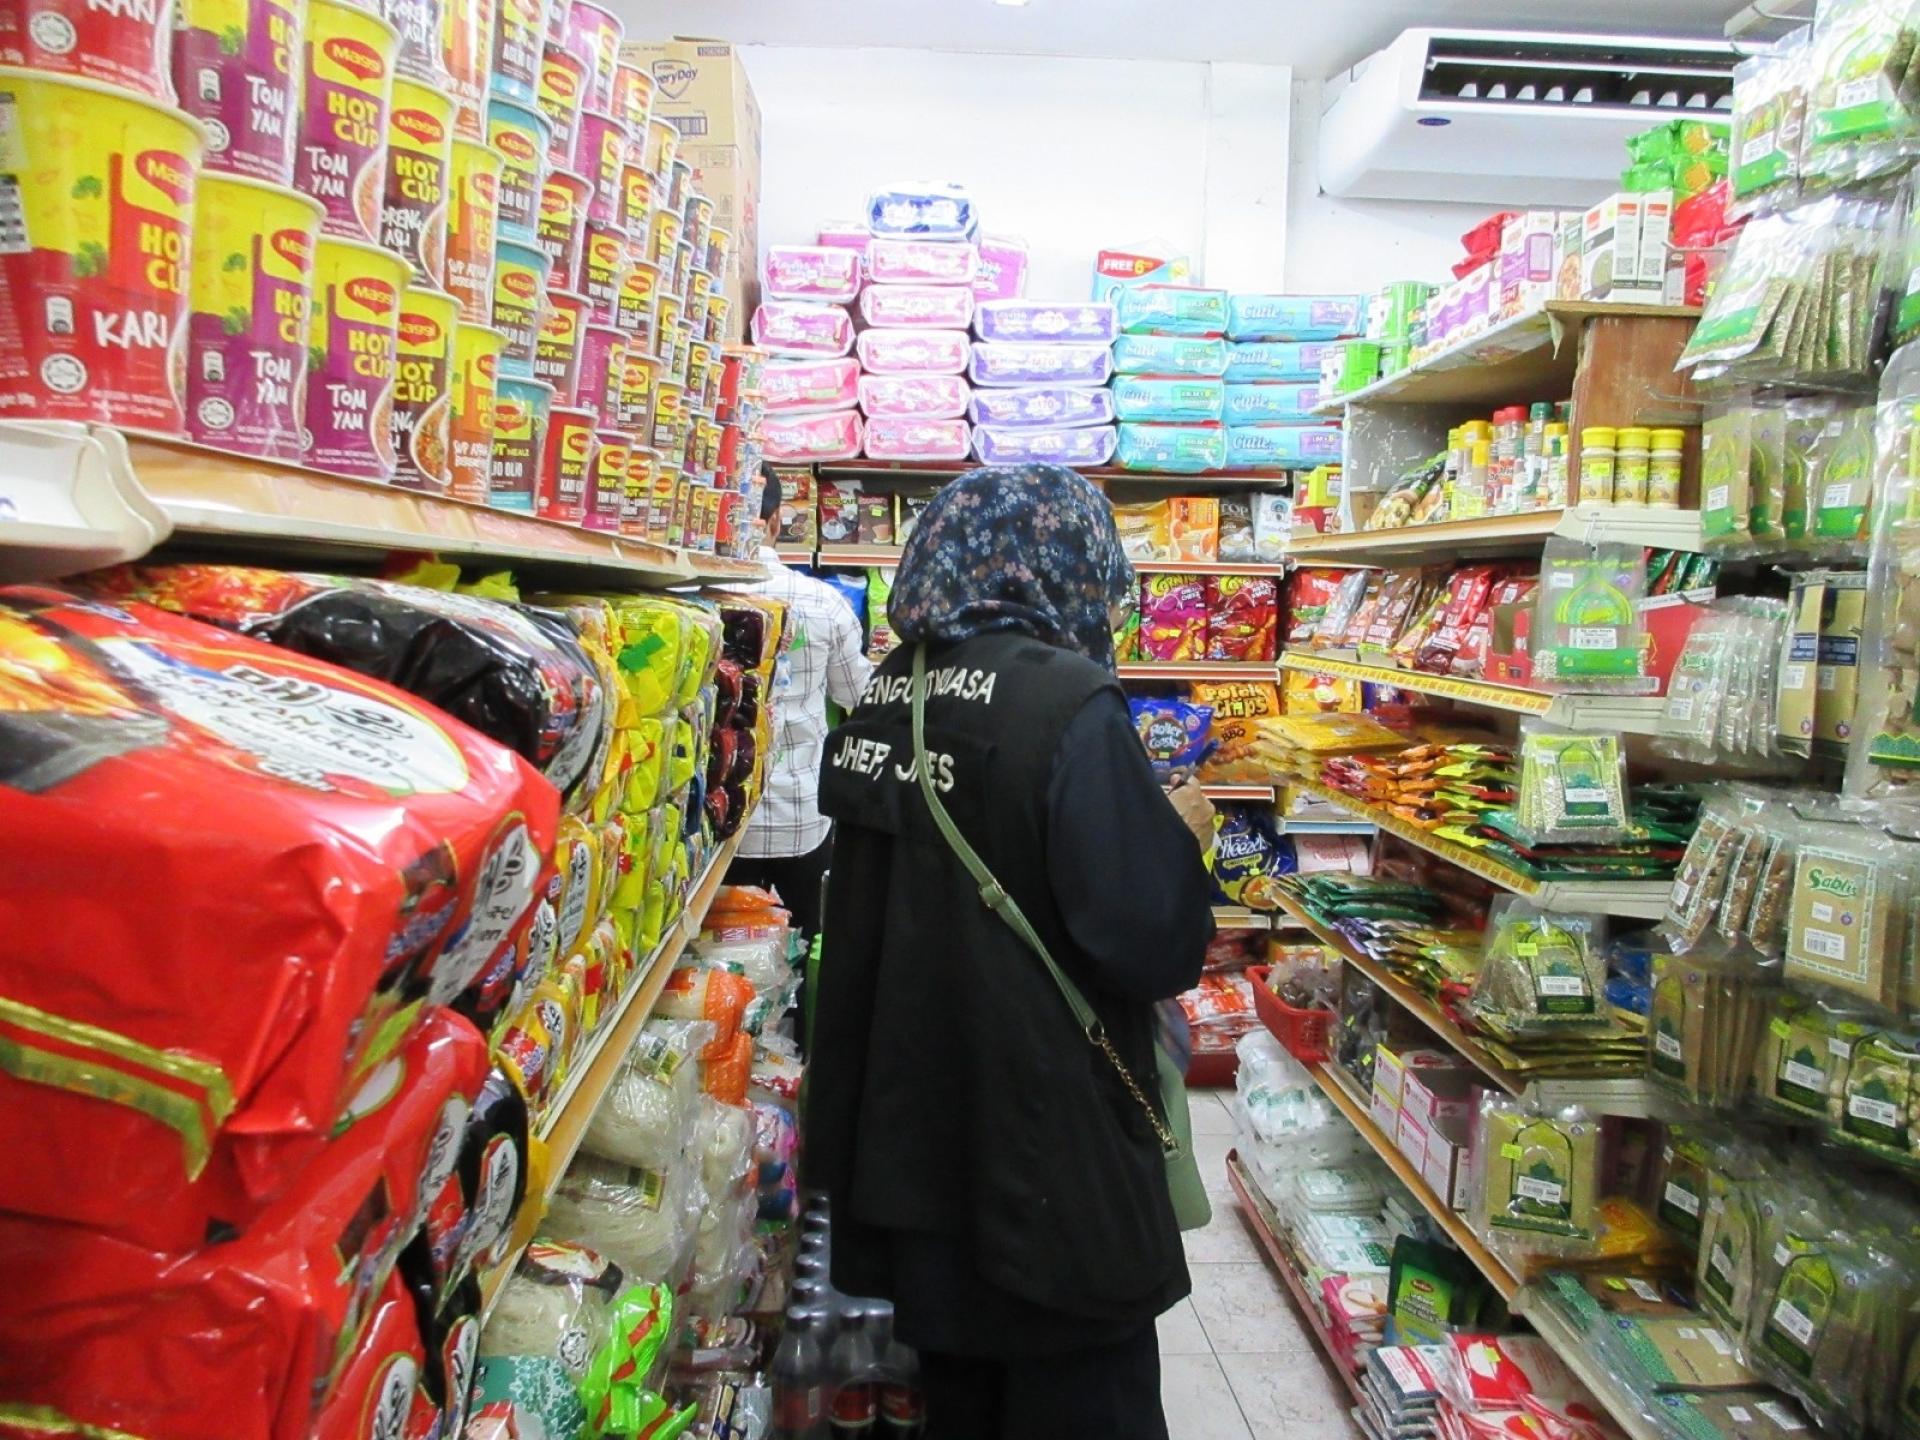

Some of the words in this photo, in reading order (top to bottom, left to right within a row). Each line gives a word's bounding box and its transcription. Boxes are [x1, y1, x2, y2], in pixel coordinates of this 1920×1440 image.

[328, 91, 380, 122] HOT
[334, 118, 381, 149] CUP
[395, 156, 440, 184] HOT
[401, 178, 440, 204] CUP
[1103, 259, 1134, 272] FREE
[1134, 259, 1145, 275] 6
[92, 310, 169, 350] KARI
[348, 329, 392, 356] HOT
